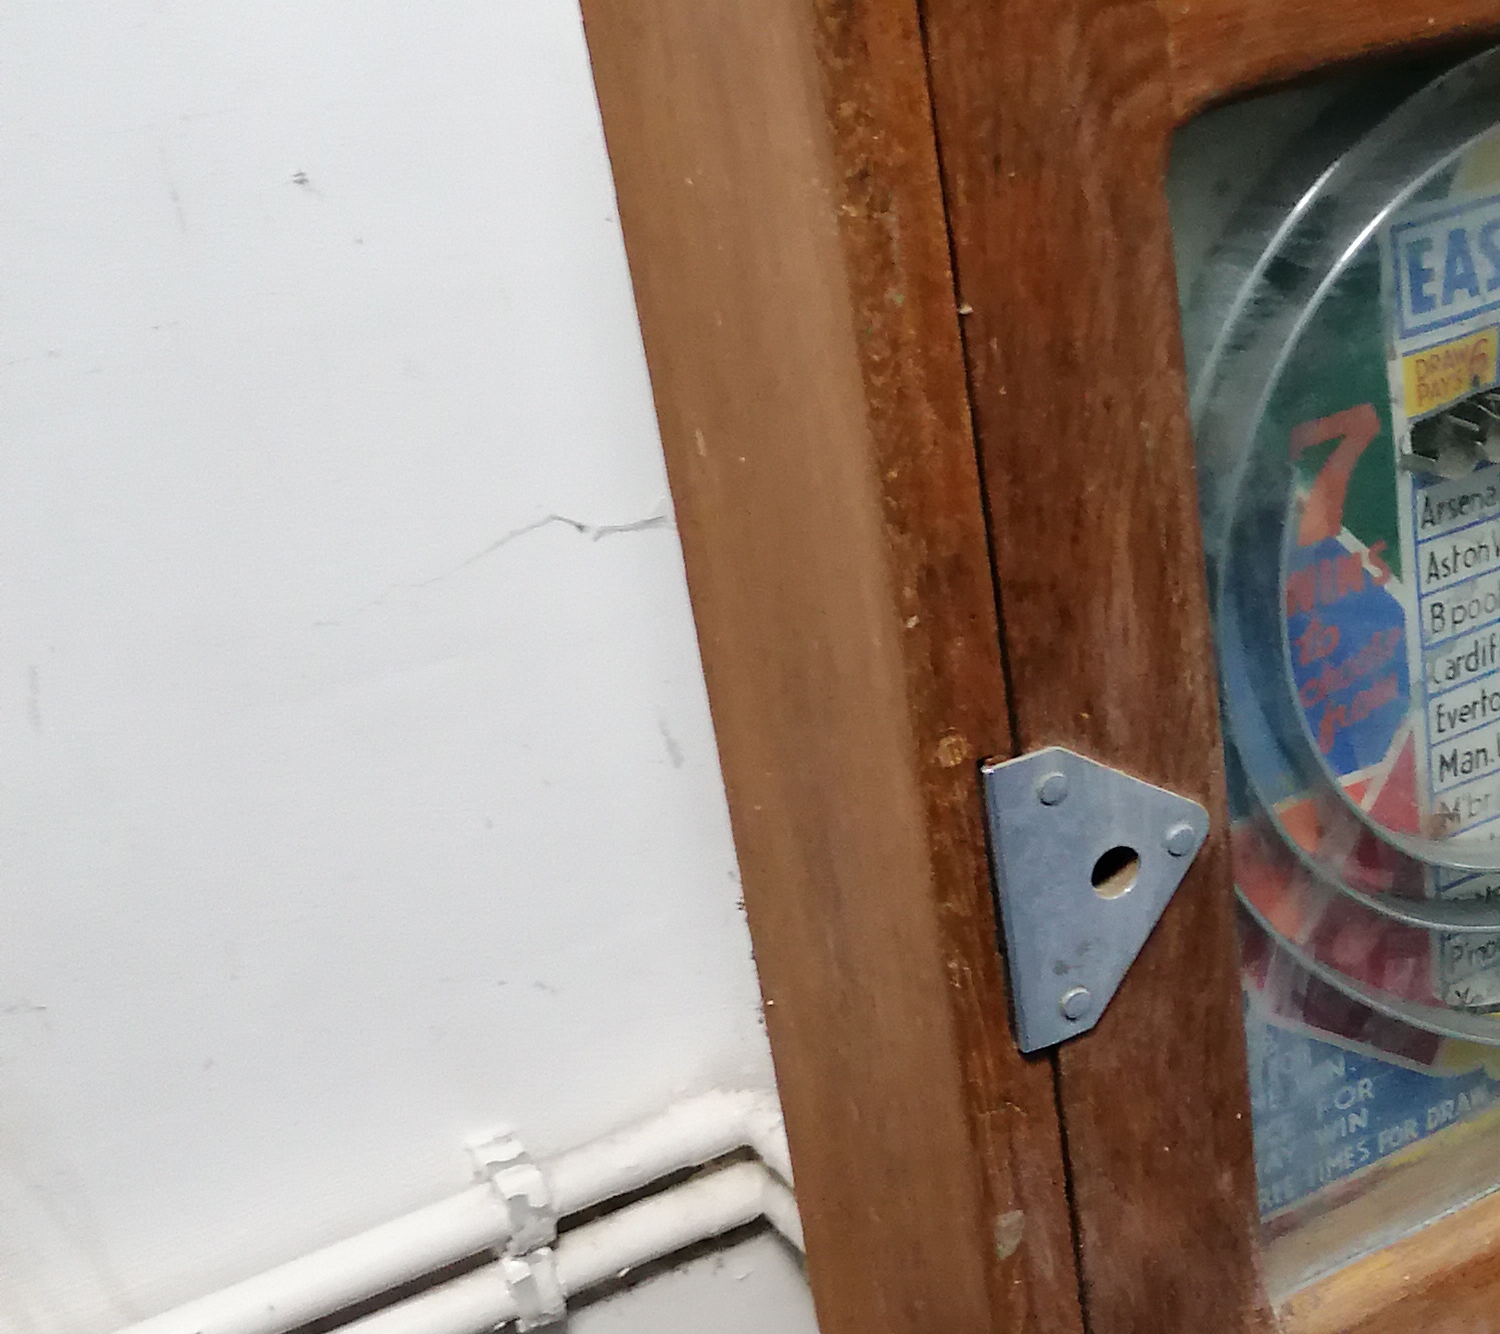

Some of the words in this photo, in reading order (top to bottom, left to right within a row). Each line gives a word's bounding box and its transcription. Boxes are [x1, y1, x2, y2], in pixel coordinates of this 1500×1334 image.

[1415, 344, 1470, 383] DRAW
[1417, 373, 1464, 407] PAYS
[1290, 402, 1381, 547] 7
[1296, 617, 1340, 665] to
[1316, 1078, 1374, 1120] FOR
[1308, 1140, 1370, 1188] TIMES
[1378, 1119, 1419, 1153] FOR
